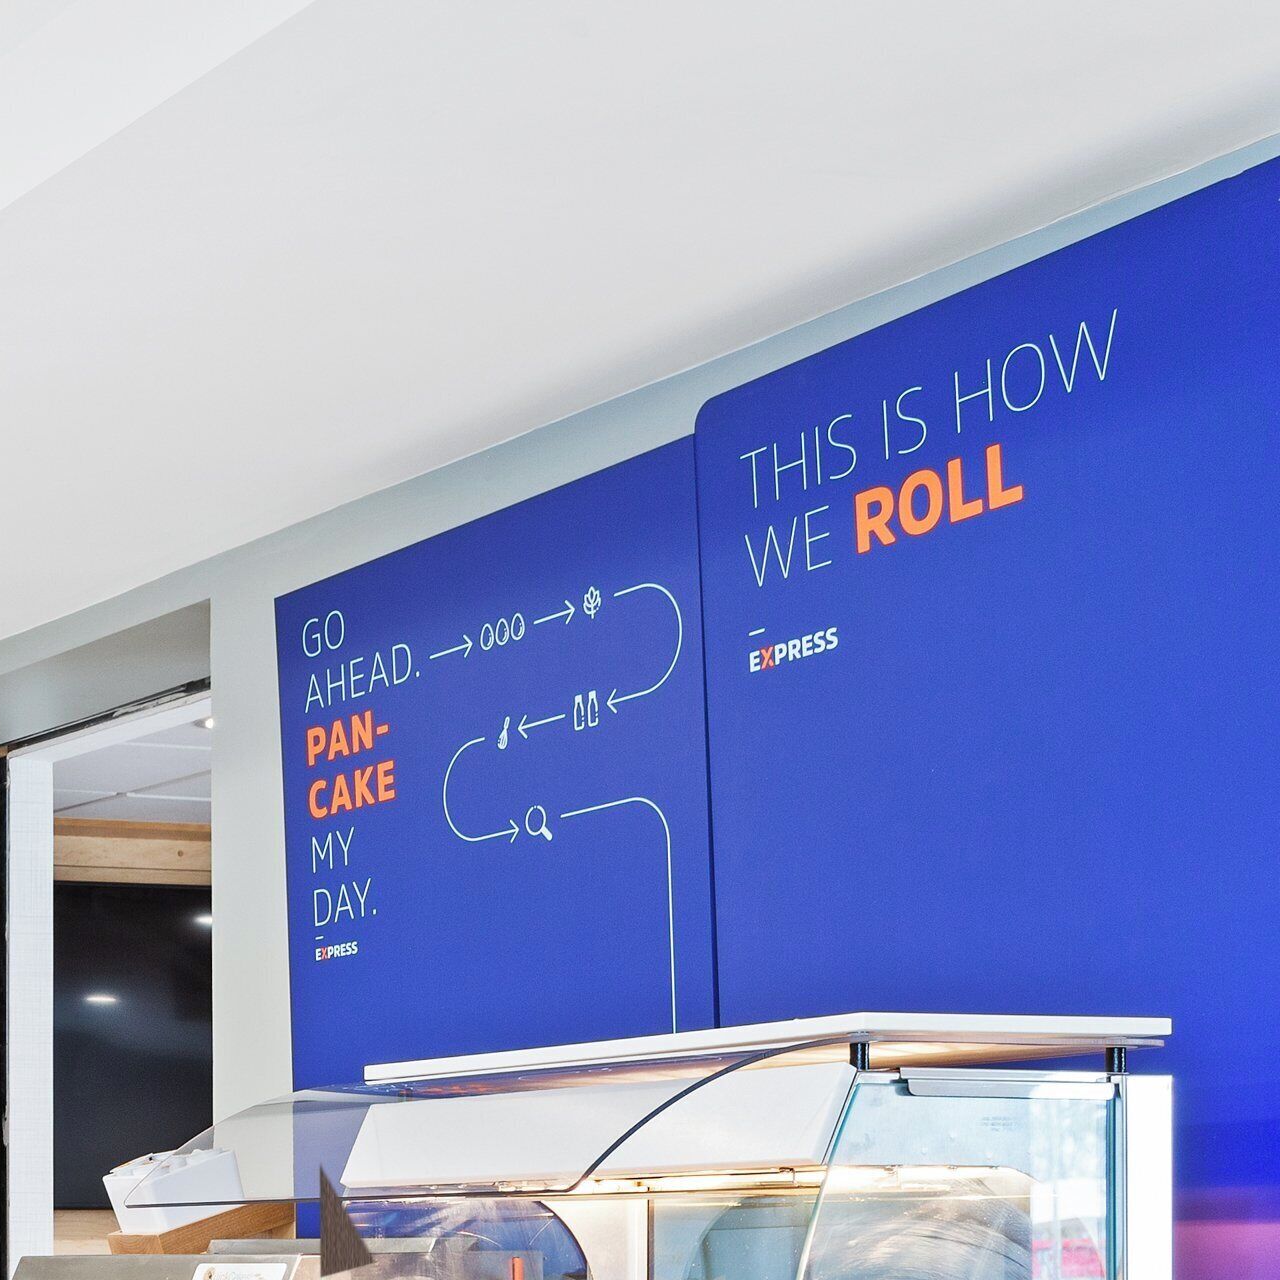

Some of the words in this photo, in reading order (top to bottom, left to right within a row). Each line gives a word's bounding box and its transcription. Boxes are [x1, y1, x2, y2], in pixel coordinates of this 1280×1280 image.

[739, 414, 857, 509] THIS
[882, 386, 927, 460] IS
[954, 308, 1118, 434] HOW
[744, 505, 832, 587] WE
[854, 442, 1024, 554] ROLL
[302, 610, 345, 657] GO
[749, 627, 839, 673] EXPRESS
[304, 643, 420, 713] AHEAD.
[306, 709, 390, 767] PAN-
[308, 760, 396, 819] CAKE
[311, 826, 355, 874] MY
[313, 878, 377, 927] DAY.
[315, 941, 358, 962] EXPRESS
